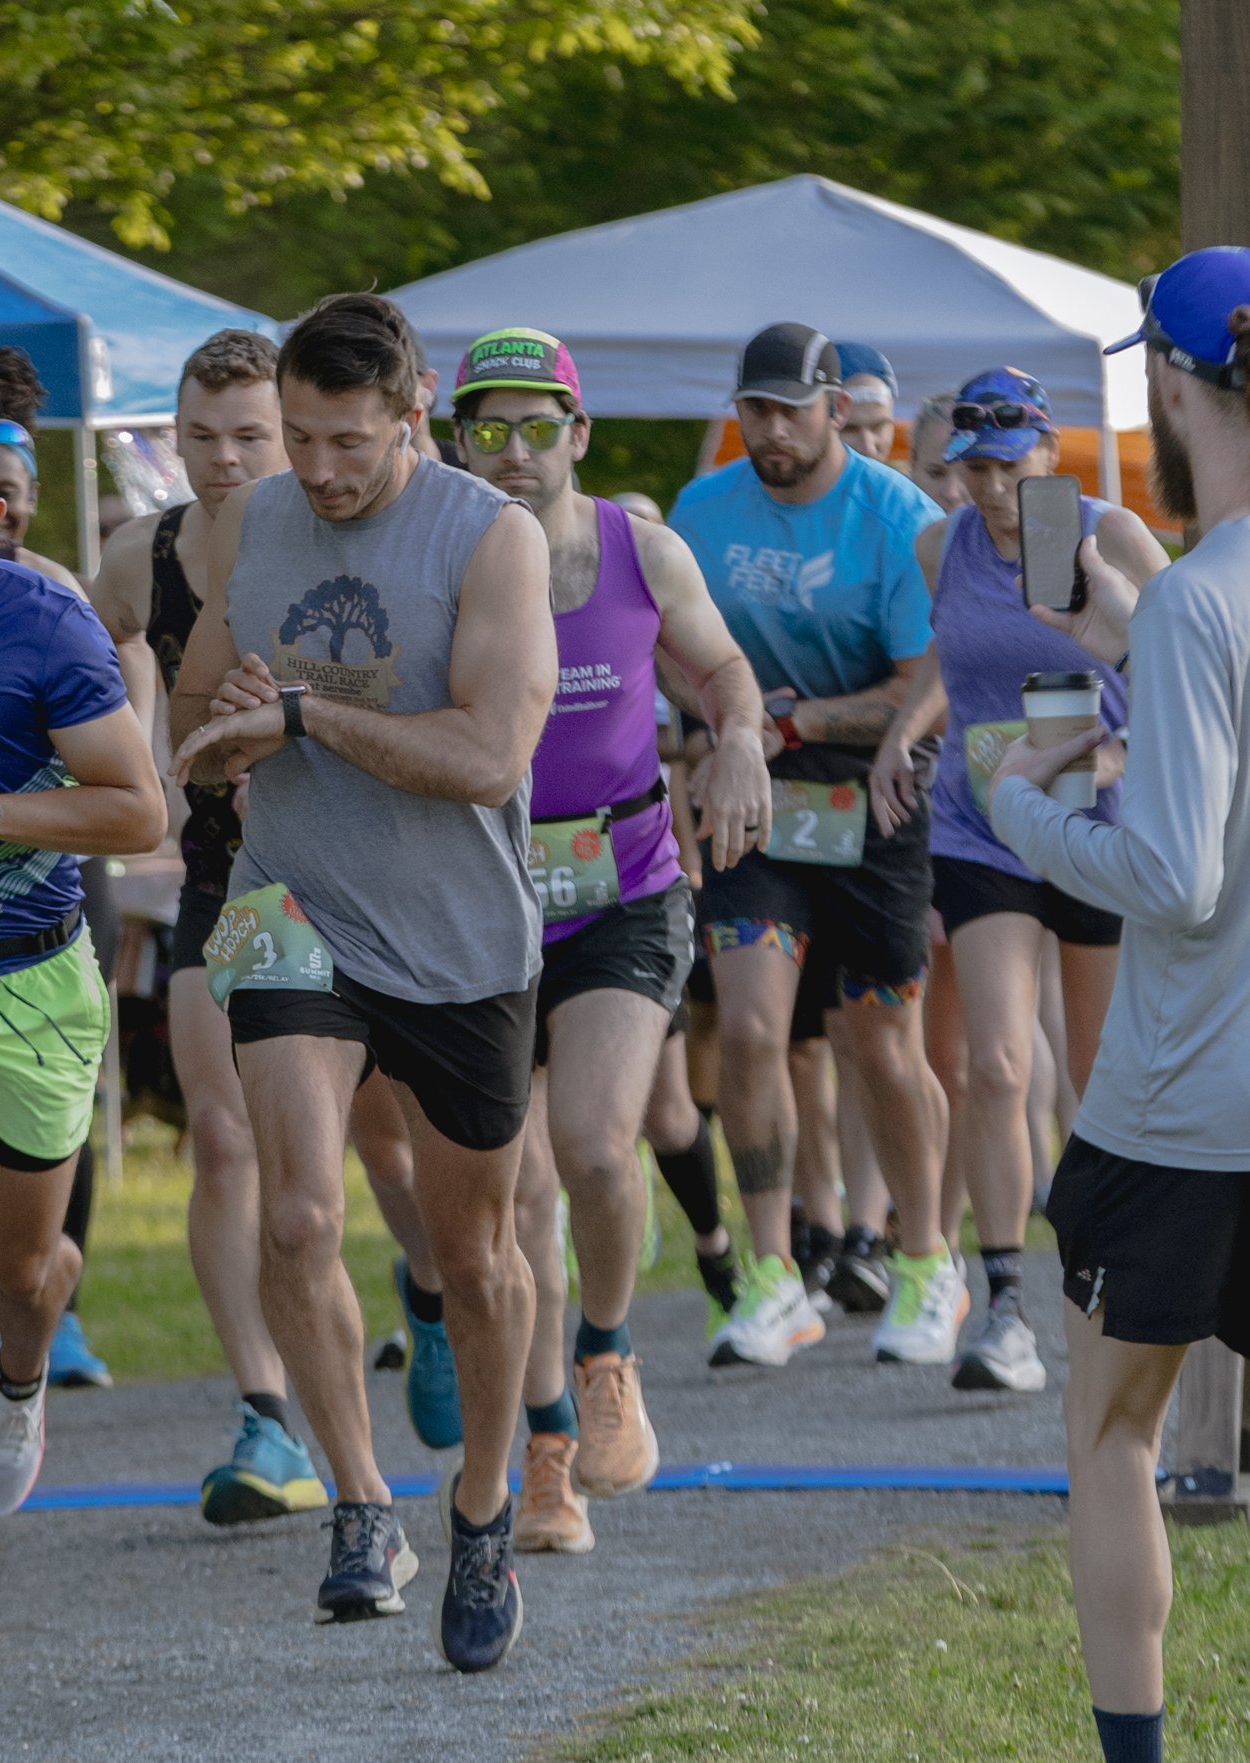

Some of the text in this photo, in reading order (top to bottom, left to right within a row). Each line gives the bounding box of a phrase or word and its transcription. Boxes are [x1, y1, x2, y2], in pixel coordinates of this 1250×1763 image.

[473, 341, 545, 365] ATLANTA
[511, 357, 541, 369] CLUB
[724, 543, 804, 573] FLEET
[287, 658, 379, 679] HILL COUNTRY
[296, 669, 370, 688] TRAIL RACE
[558, 663, 611, 680] EAM IN
[792, 810, 817, 848] 2
[252, 931, 278, 971] 3
[299, 966, 331, 977] SUMMIT
